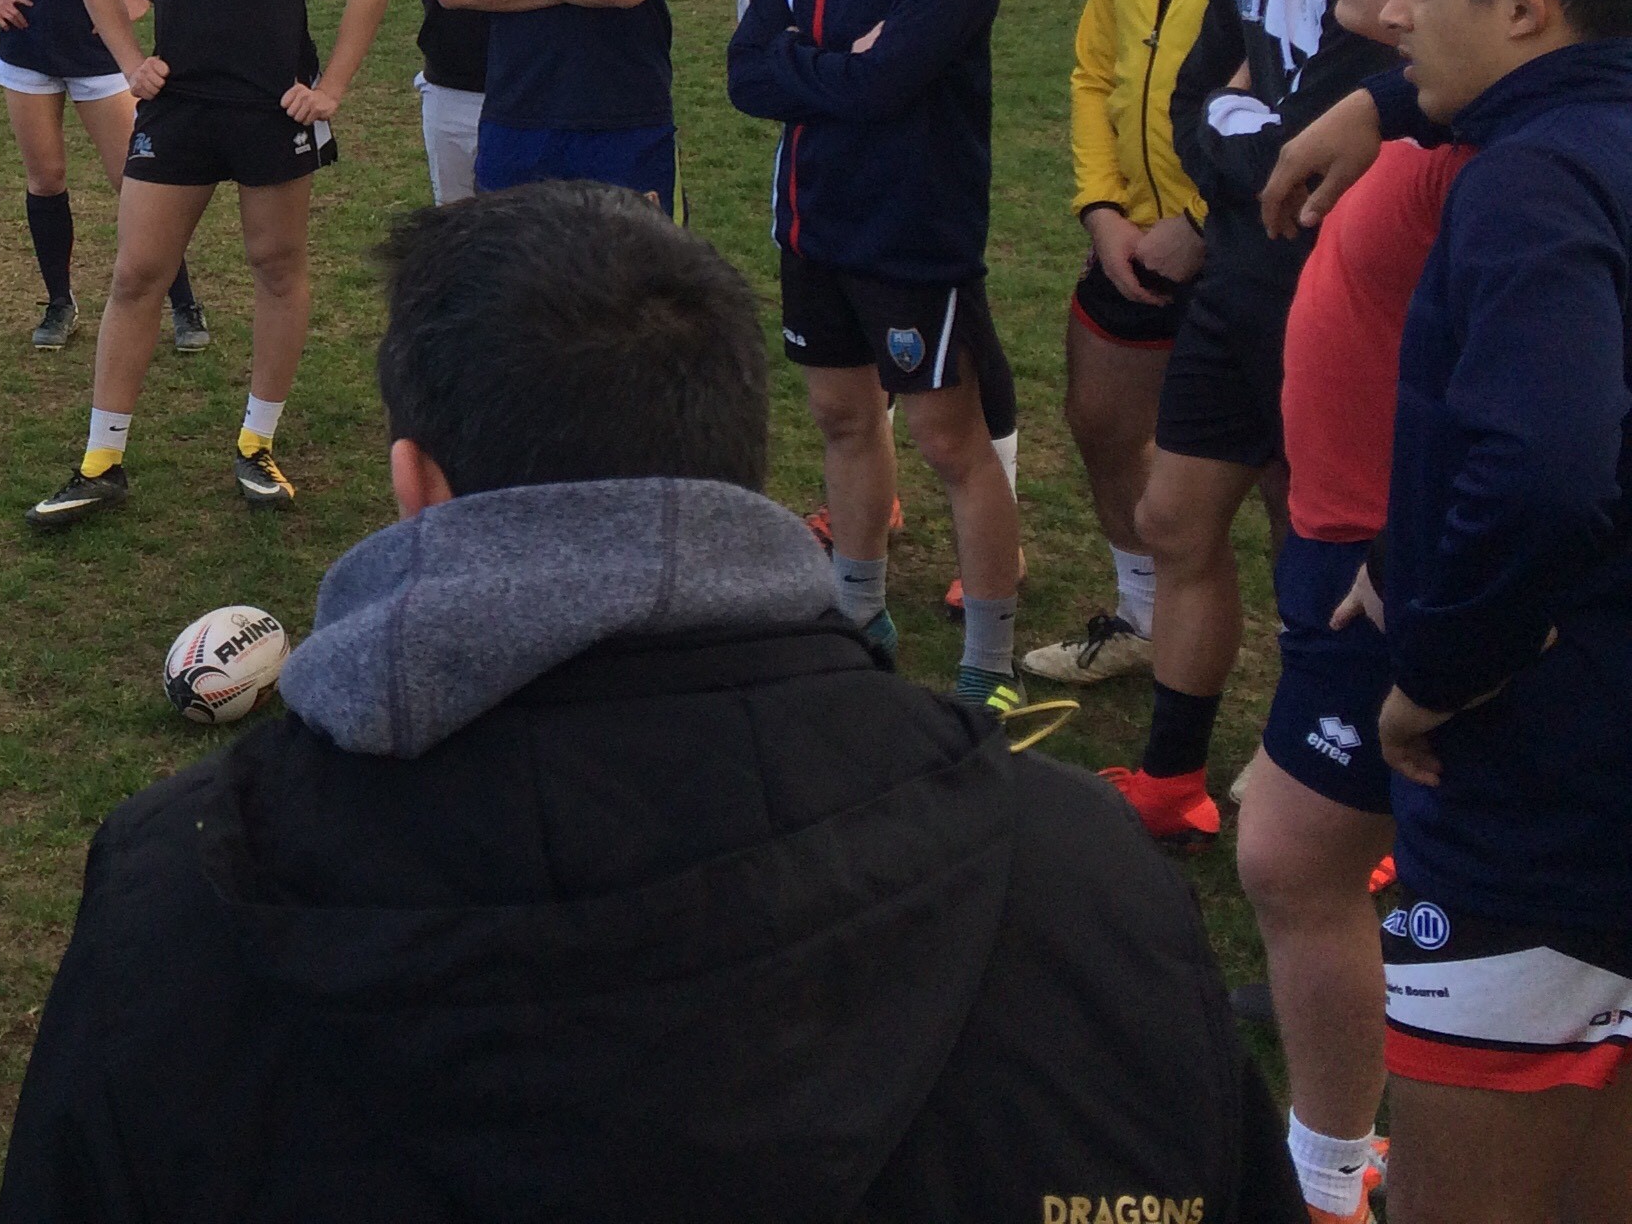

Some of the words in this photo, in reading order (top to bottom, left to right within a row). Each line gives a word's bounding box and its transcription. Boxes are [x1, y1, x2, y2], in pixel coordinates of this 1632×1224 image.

[213, 616, 280, 665] RHINO
[1307, 732, 1352, 766] errea
[1405, 985, 1451, 998] Bourrel
[1042, 1194, 1204, 1224] DRAGONS
